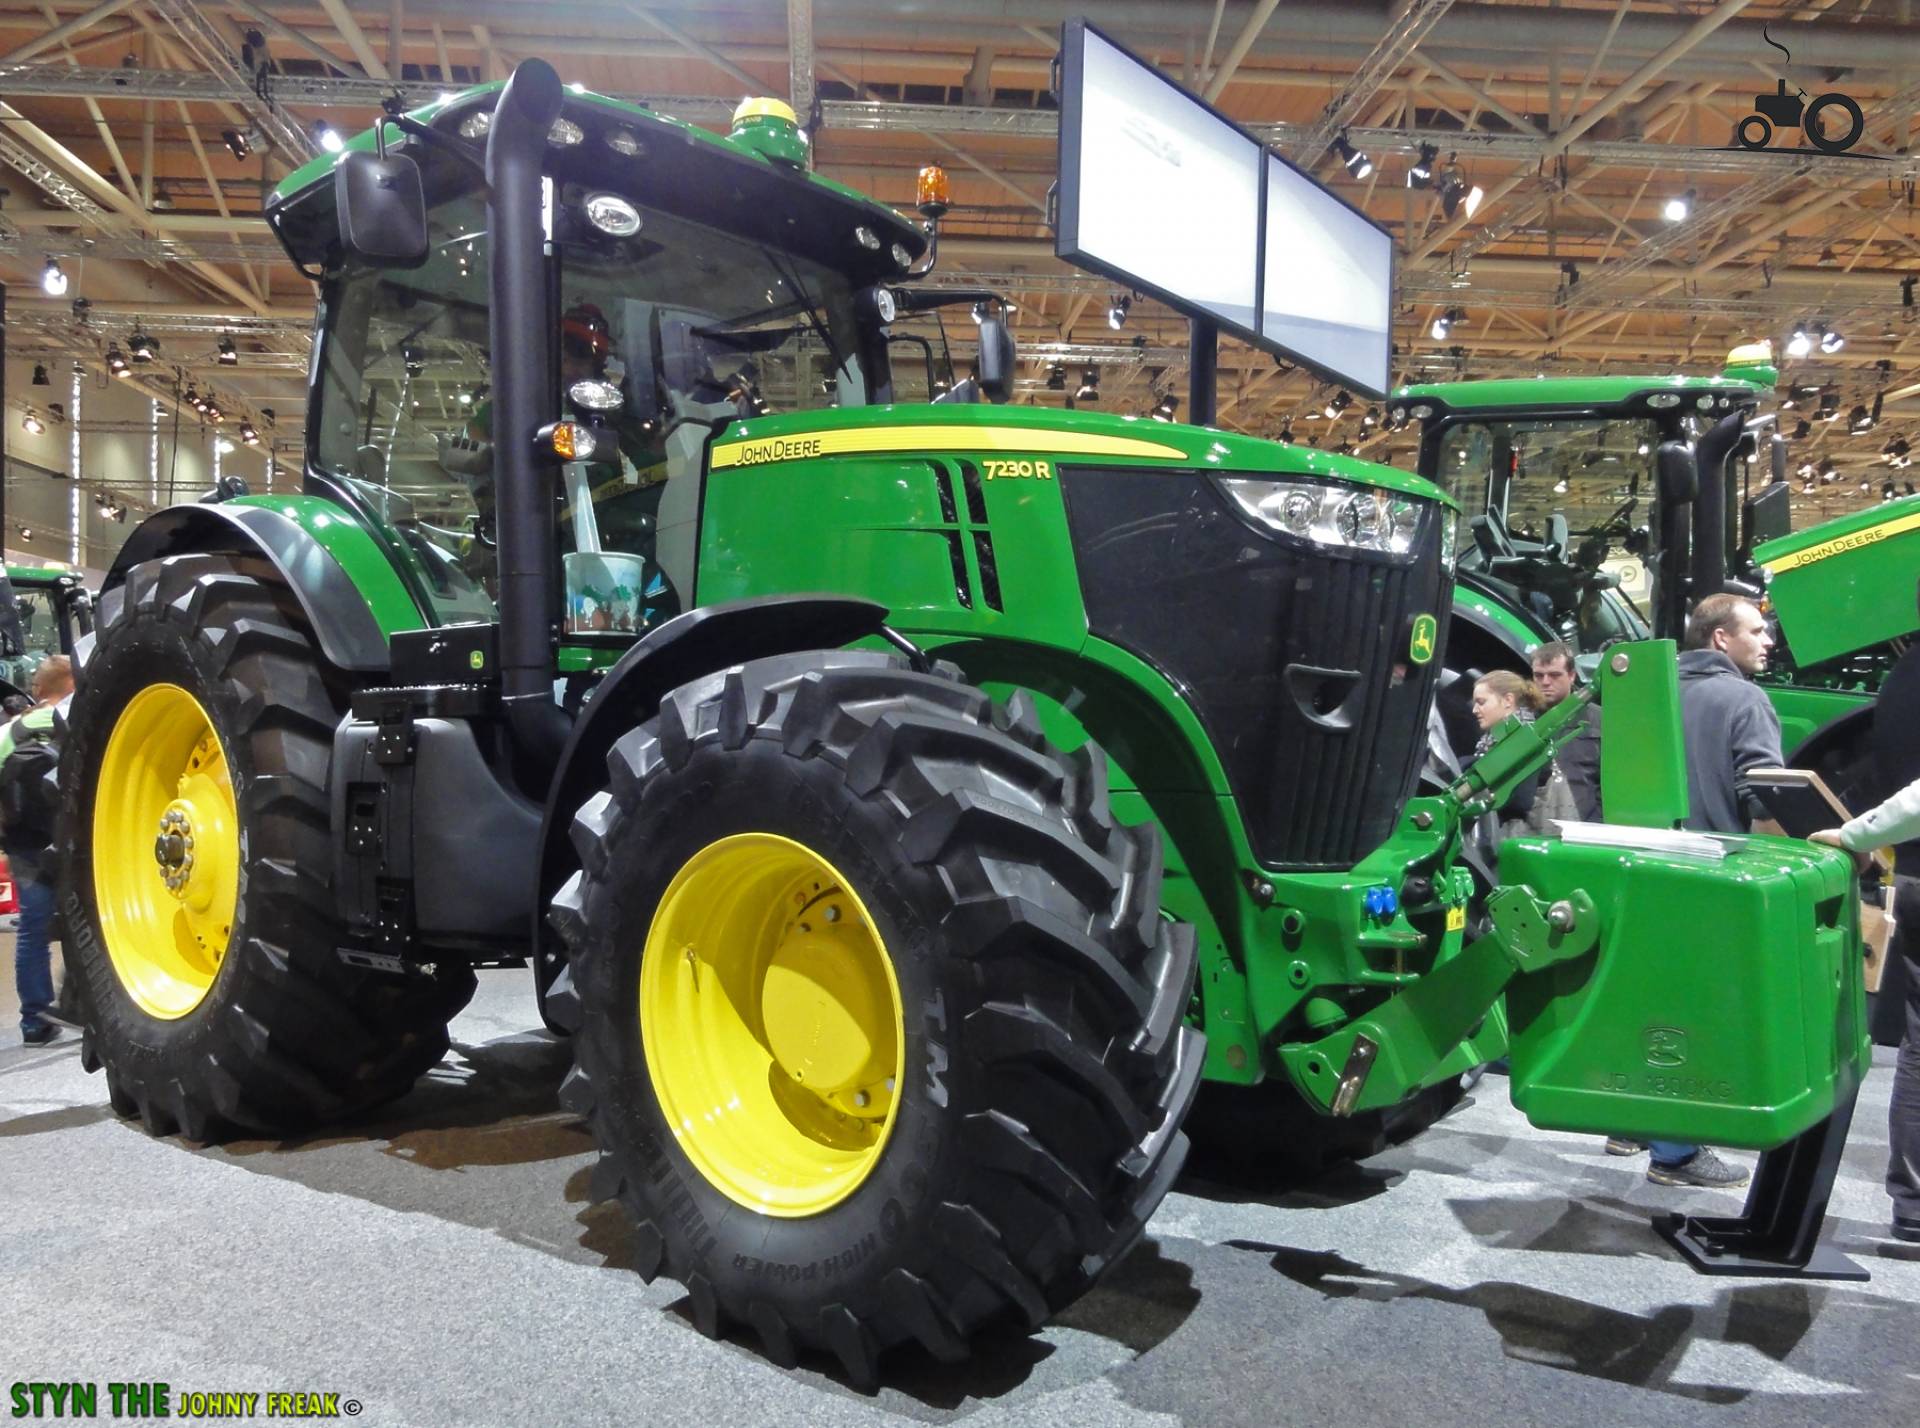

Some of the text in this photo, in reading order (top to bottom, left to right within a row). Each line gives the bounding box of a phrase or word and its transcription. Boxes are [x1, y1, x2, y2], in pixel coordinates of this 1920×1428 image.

[736, 439, 822, 464] JOHN DEERE
[982, 461, 1051, 480] 7230 R
[1793, 529, 1886, 567] JOHN DEERE
